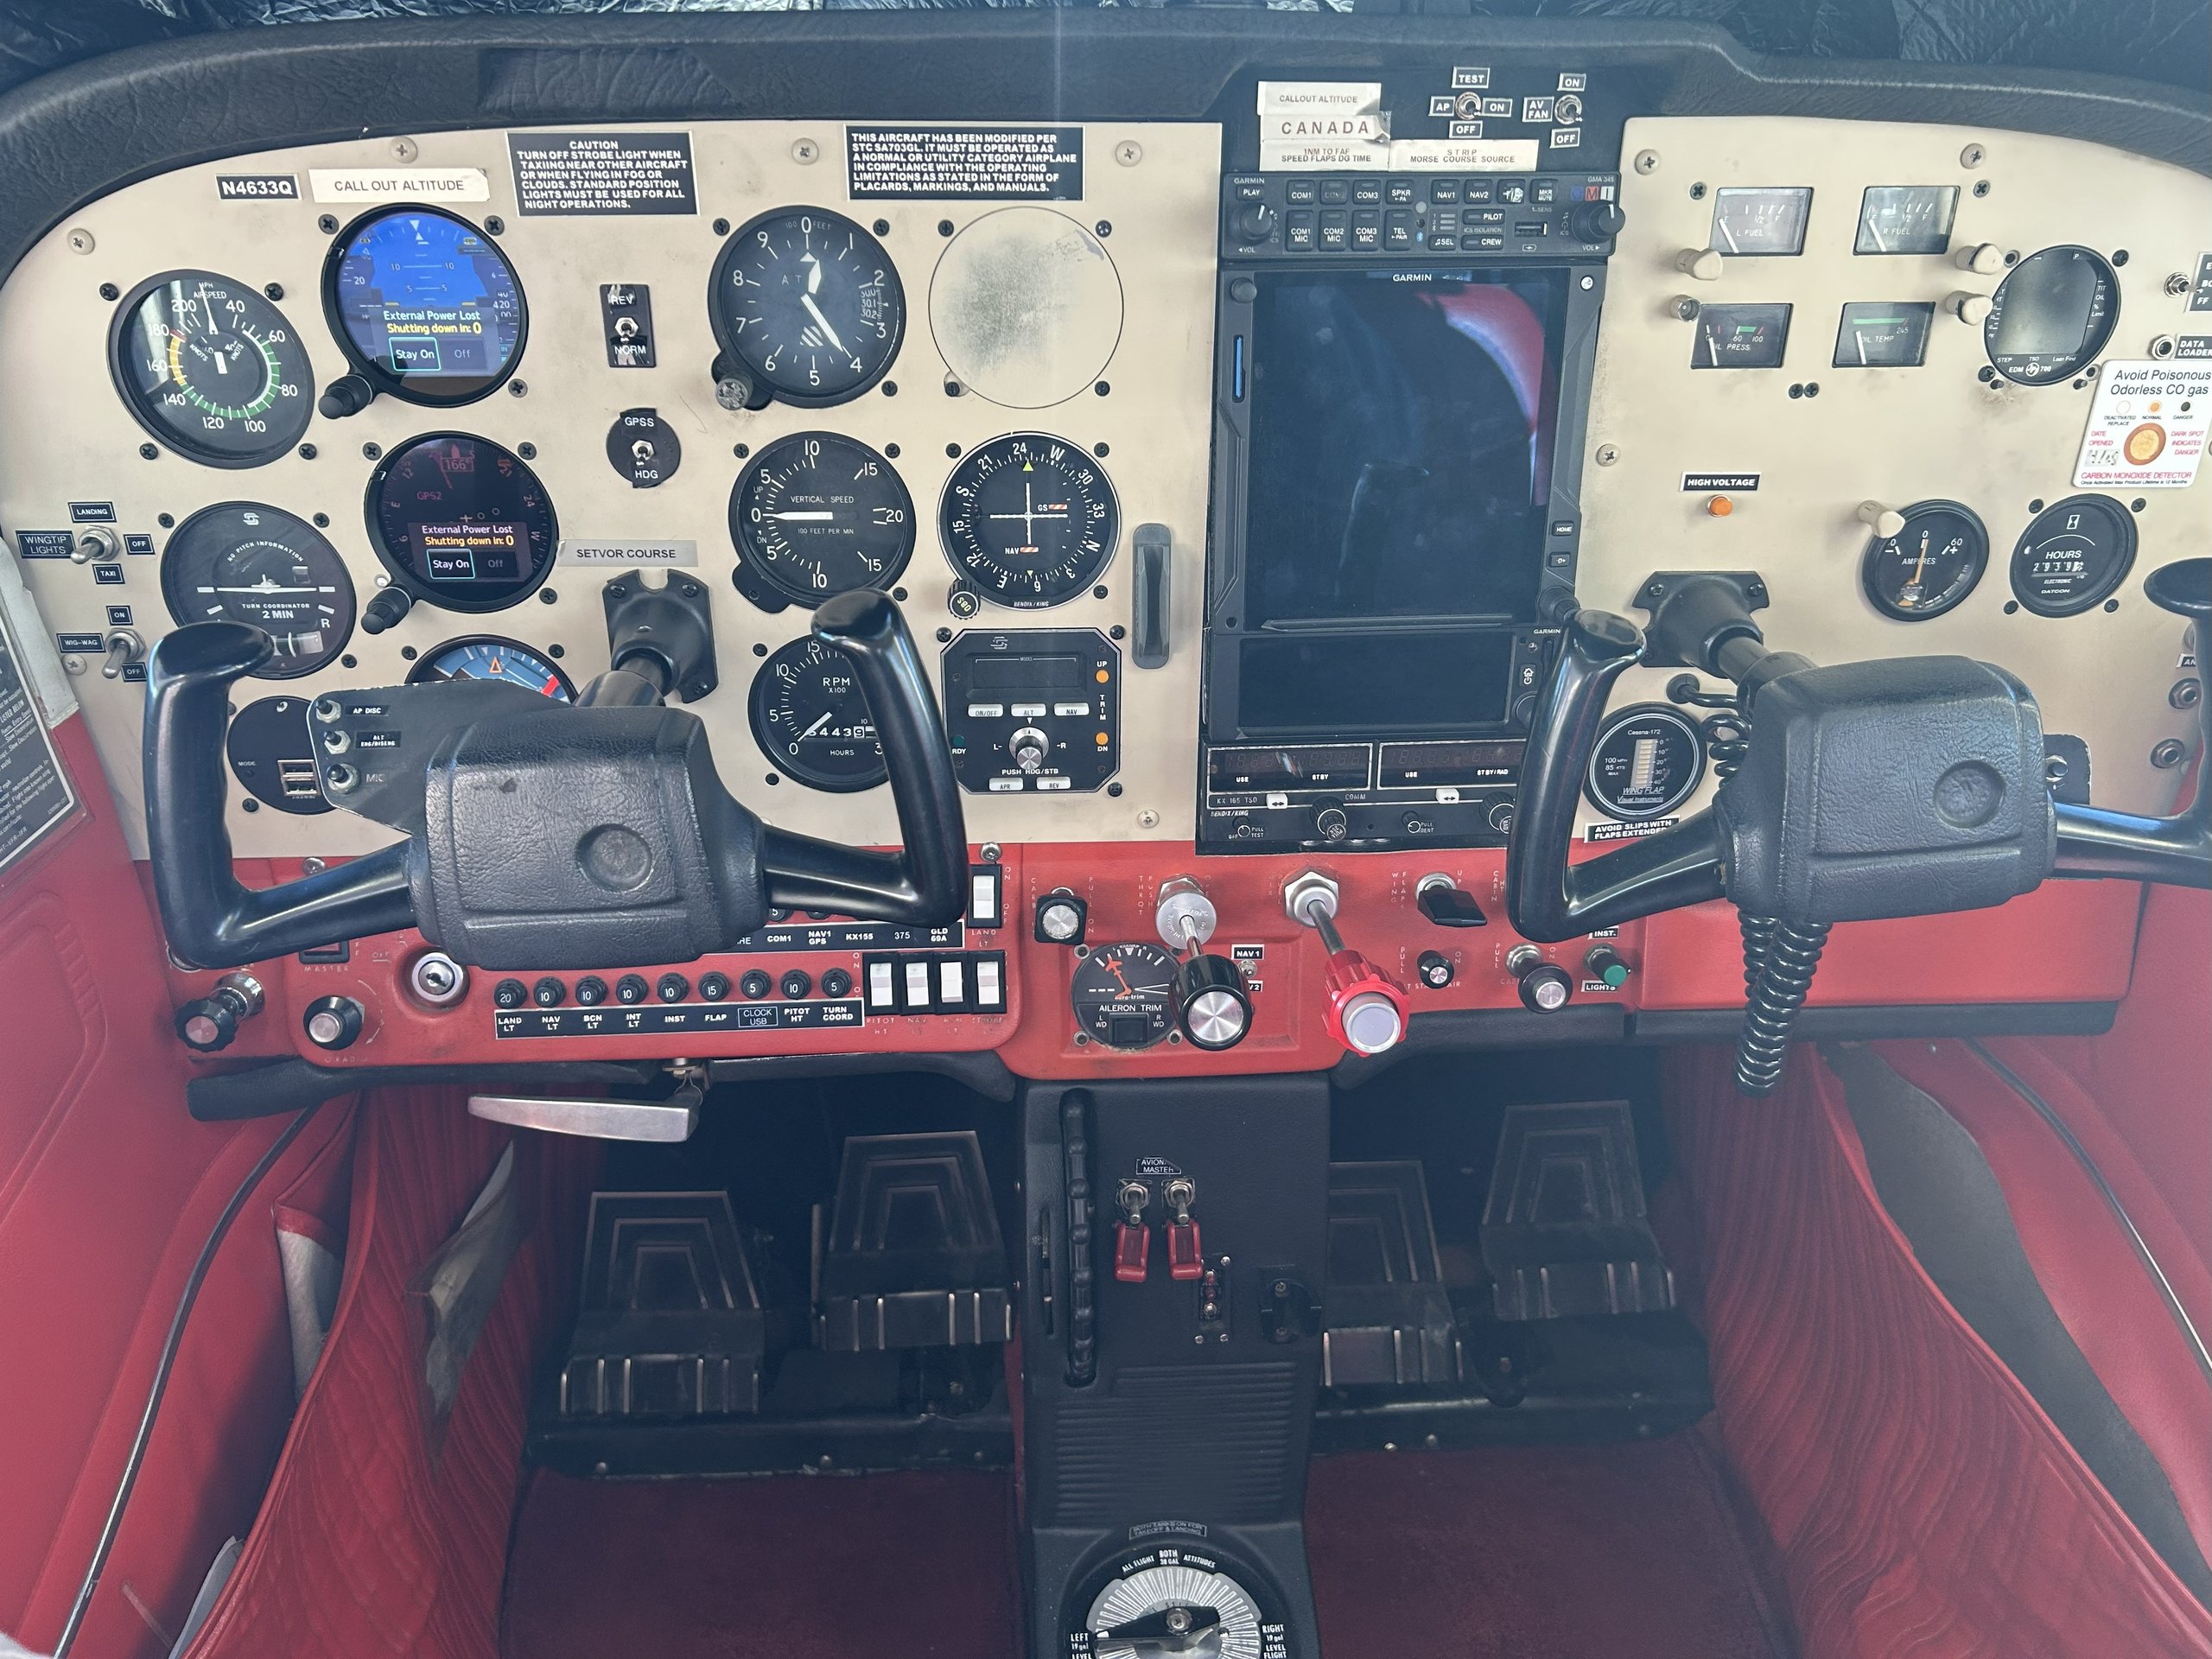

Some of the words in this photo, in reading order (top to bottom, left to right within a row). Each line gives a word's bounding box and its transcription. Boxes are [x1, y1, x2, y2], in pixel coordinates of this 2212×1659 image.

[1566, 79, 1580, 87] ON
[1436, 103, 1450, 111] AP
[1529, 101, 1543, 110] AV
[1529, 111, 1548, 119] FAN
[879, 134, 930, 143] AIRCRAFT
[931, 134, 953, 143] HAS
[955, 134, 983, 143] BEEN
[985, 134, 1034, 143] MODIFIED
[1037, 134, 1057, 143] PER
[1556, 134, 1575, 143] OFF
[569, 141, 618, 149] CAUTION
[852, 143, 873, 152] STC
[874, 143, 923, 152] SA703GL.
[925, 143, 936, 152] IT
[853, 153, 861, 162] A
[862, 153, 906, 162] NORMAL
[925, 154, 965, 162] UTILITY
[967, 154, 1023, 162] CATEGORY
[1025, 154, 1077, 162] AIRPLANE
[222, 181, 293, 194] N4633Q
[335, 181, 369, 191] CALL
[372, 181, 400, 191] OUT
[403, 181, 464, 190] ALTITUDE
[522, 181, 569, 189] CLOUDS.
[1392, 273, 1432, 282] GARMIN
[226, 301, 245, 313] 40
[384, 311, 425, 321] External
[428, 311, 456, 321] Power
[460, 311, 480, 321] Lost
[387, 323, 429, 335] Shutting
[432, 323, 458, 333] down
[460, 324, 471, 333] in:
[474, 322, 481, 334] 0
[269, 330, 285, 342] 60
[614, 346, 646, 354] NORM
[396, 350, 417, 360] Stay
[421, 350, 435, 359] On
[2114, 370, 2148, 380] Avoid
[2152, 370, 2211, 380] Poisonous
[282, 385, 297, 397] 80
[2111, 385, 2162, 395] Odorless
[2166, 385, 2184, 395] CO
[2188, 386, 2209, 397] gas
[245, 421, 266, 432] 100
[625, 417, 654, 427] GPSS
[635, 470, 658, 479] HDG
[423, 525, 461, 534] External
[463, 525, 490, 534] Power
[25, 536, 67, 544] WINGTIP
[425, 537, 465, 546] Shutting
[505, 537, 513, 545] 0
[30, 545, 67, 555] LIGHTS
[577, 550, 624, 558] SETVOR
[627, 550, 676, 558] COURSE
[2045, 550, 2082, 559] HOURS
[433, 560, 453, 569] Stay
[263, 610, 270, 619] 2
[272, 610, 294, 619] MIN
[823, 677, 850, 686] RPM
[1262, 1624, 1284, 1633] RIGHT
[1071, 1633, 1089, 1642] LEFT
